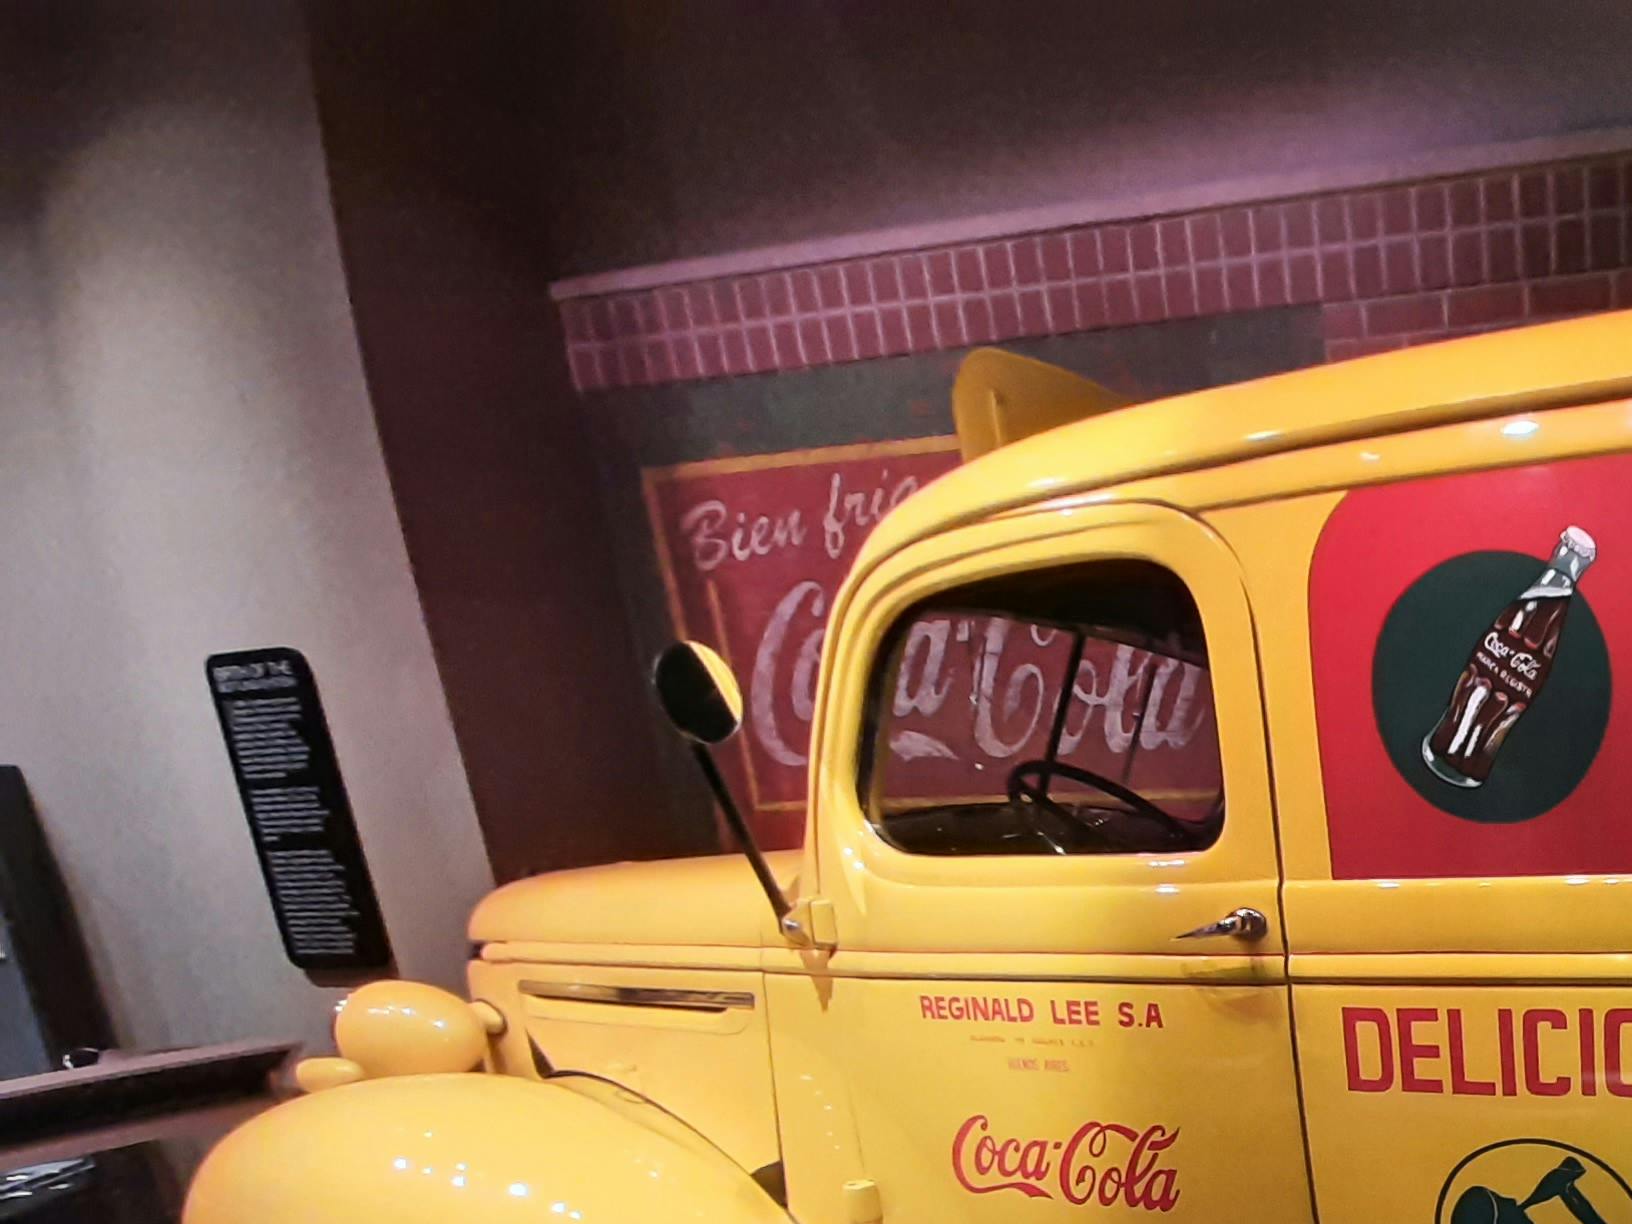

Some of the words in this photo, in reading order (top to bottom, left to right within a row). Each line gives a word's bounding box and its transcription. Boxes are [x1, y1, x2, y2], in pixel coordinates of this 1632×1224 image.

[680, 499, 807, 571] Bien
[919, 995, 1034, 1023] REGINALD
[1050, 999, 1101, 1027] LEE
[1117, 1001, 1164, 1029] S.A
[951, 1114, 1181, 1213] Coca-Cola
